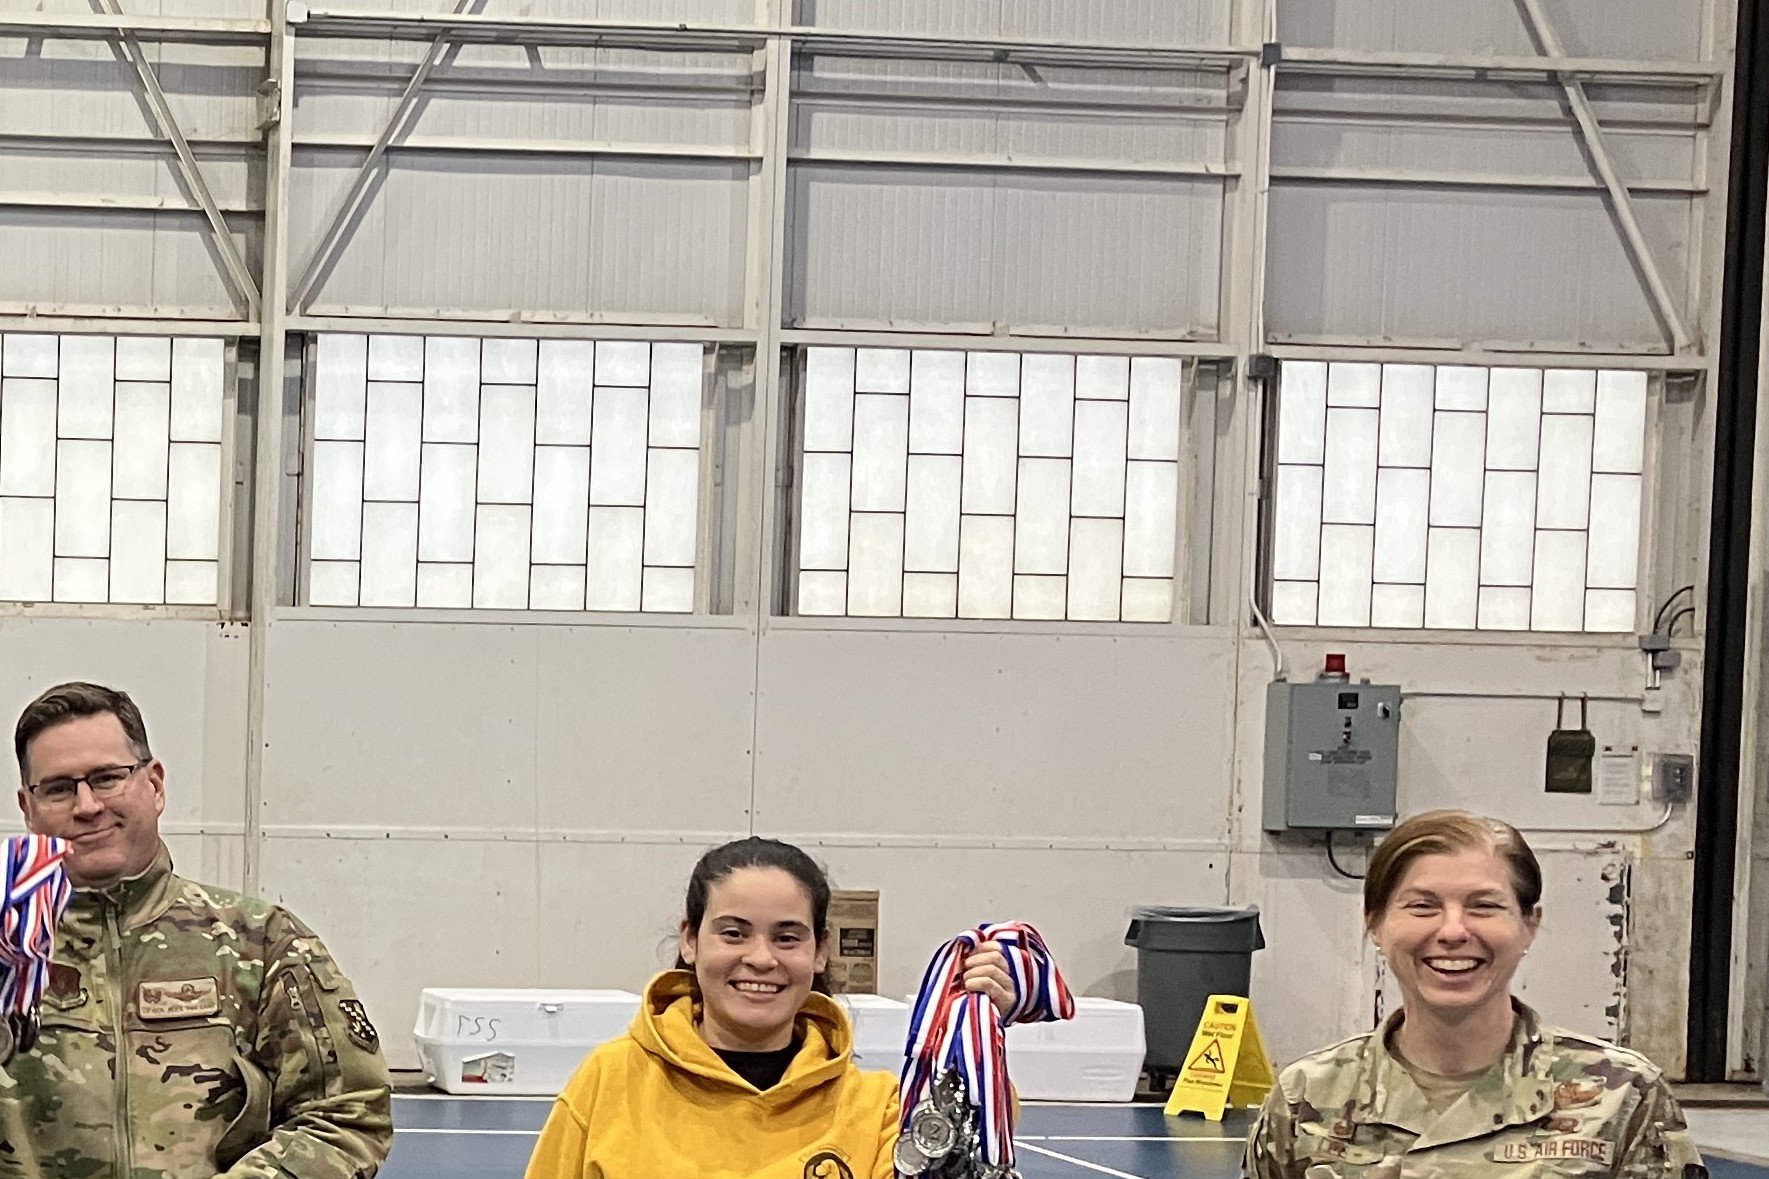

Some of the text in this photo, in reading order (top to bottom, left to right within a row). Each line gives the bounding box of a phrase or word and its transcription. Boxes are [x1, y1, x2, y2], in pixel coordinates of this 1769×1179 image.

[927, 1123, 942, 1141] 2
[1534, 1140, 1558, 1157] AIR
[1562, 1139, 1607, 1161] FORCE
